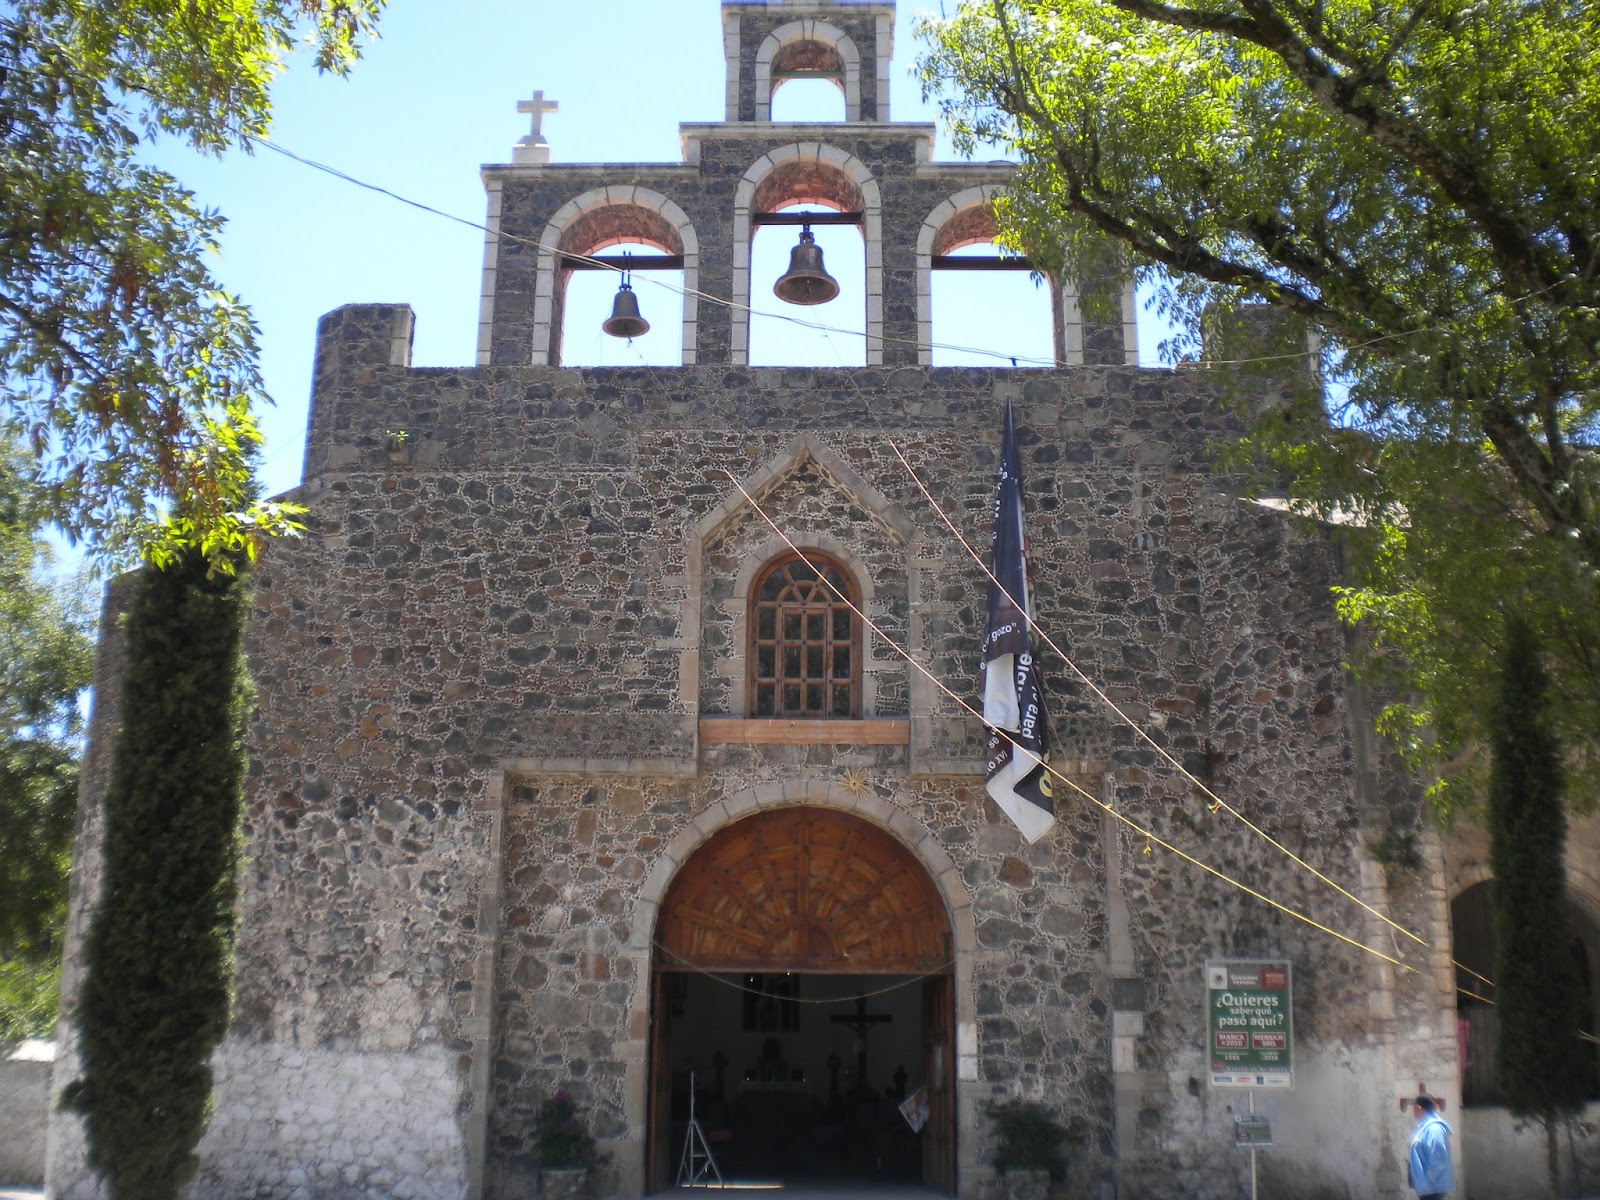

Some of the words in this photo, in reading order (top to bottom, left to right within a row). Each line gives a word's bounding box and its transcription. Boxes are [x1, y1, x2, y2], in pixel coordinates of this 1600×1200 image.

[1022, 703, 1039, 740] para
[1216, 992, 1279, 1008] ¿Quieres
[1230, 1006, 1253, 1015] saber
[1255, 1006, 1272, 1018] qué
[1219, 1015, 1248, 1029] pasó
[1250, 1013, 1284, 1030] aquí?
